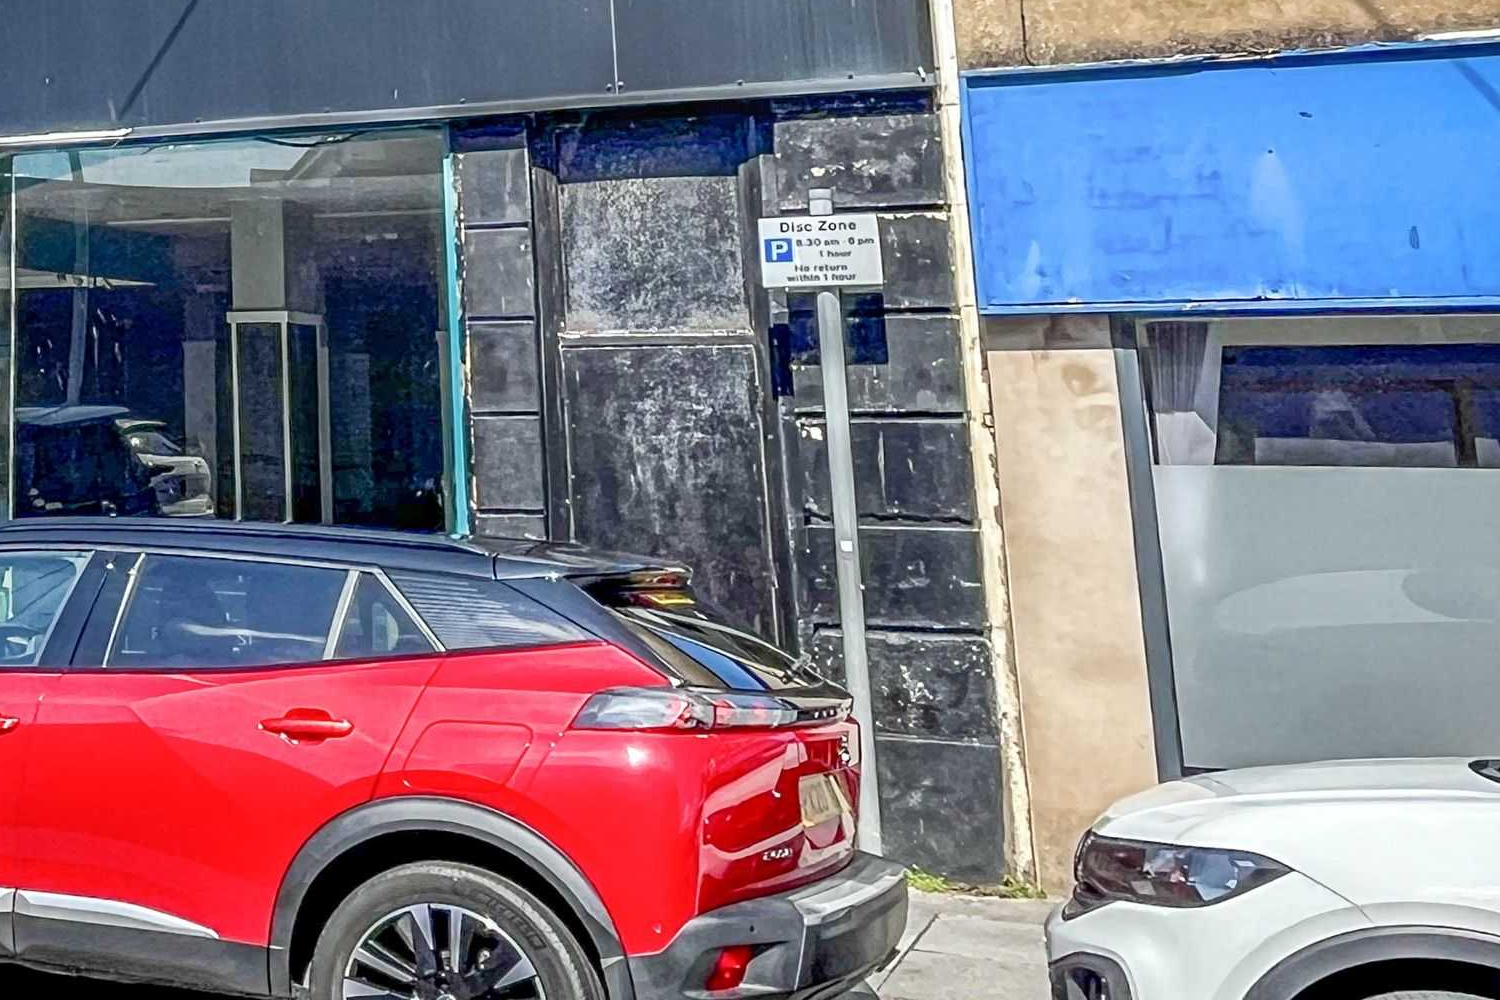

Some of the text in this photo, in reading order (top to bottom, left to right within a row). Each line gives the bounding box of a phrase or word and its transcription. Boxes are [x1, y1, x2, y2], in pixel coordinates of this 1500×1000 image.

[780, 220, 857, 233] Disc Zone
[813, 264, 848, 272] return
